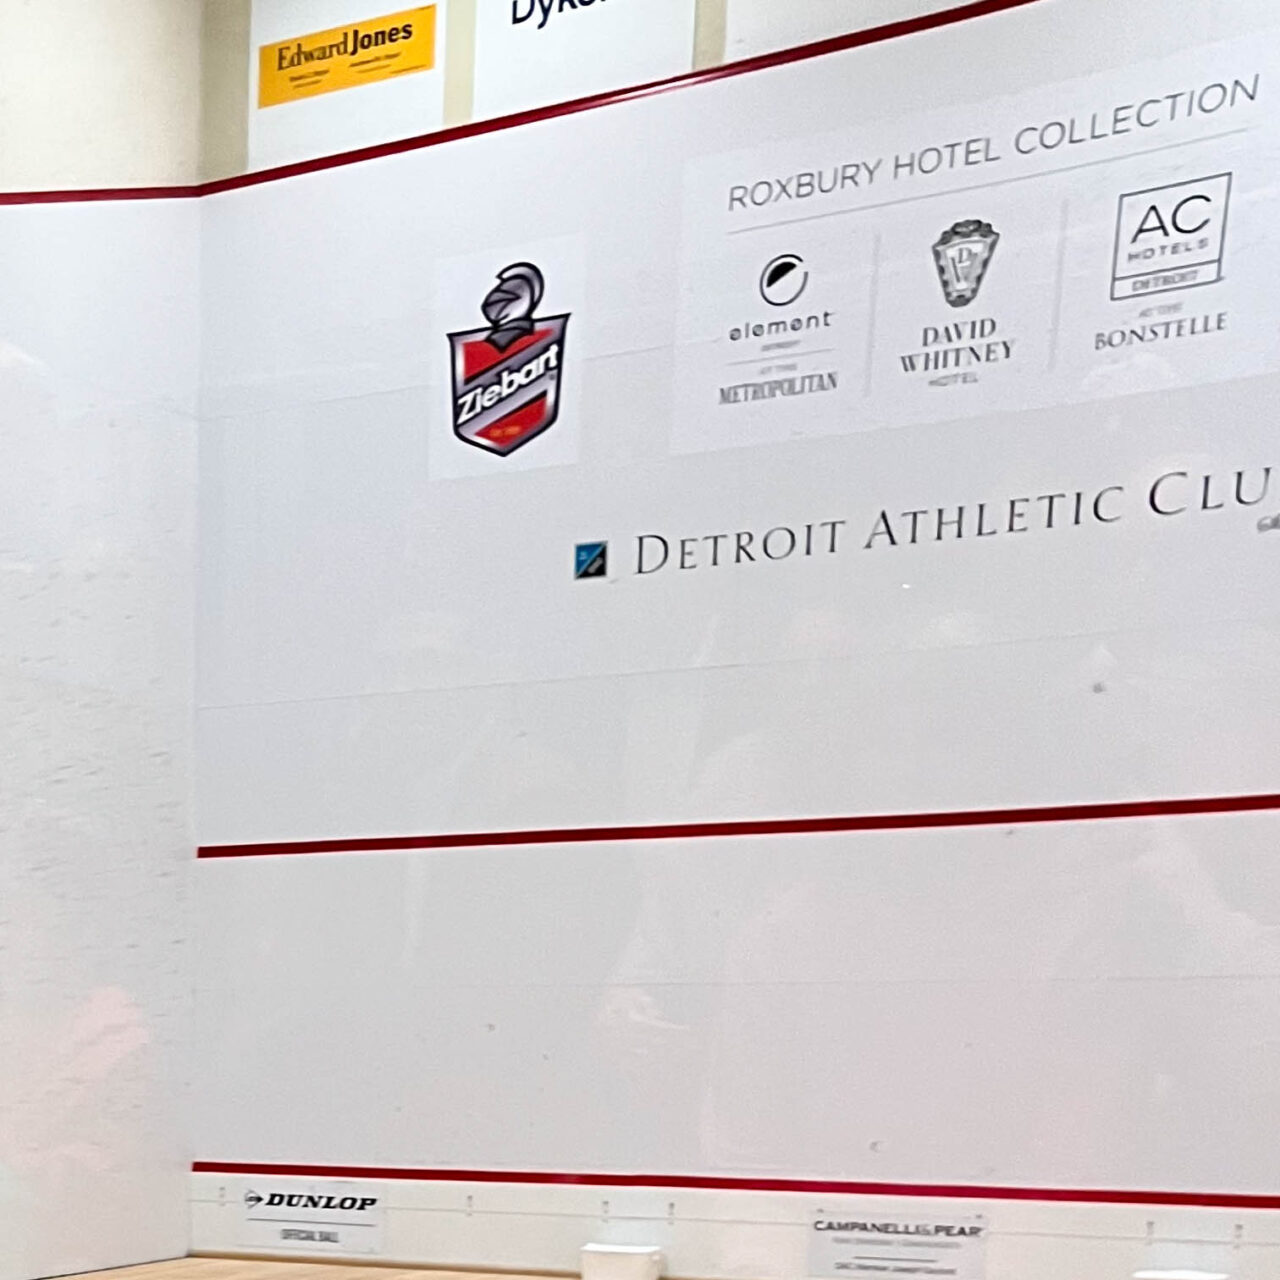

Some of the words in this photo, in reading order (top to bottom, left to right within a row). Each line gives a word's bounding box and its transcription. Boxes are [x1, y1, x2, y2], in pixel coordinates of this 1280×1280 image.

[728, 158, 883, 212] ROXBURY
[893, 137, 1001, 179] HOTEL
[1014, 73, 1260, 154] COLLECTION
[1130, 194, 1212, 244] AC
[922, 317, 997, 347] DAVID
[1094, 311, 1227, 351] BONSTELLE
[900, 338, 1016, 373] WHITNEY
[457, 343, 559, 424] Ziebart
[634, 520, 847, 575] DETROIT
[863, 485, 1125, 549] ATHLETIC
[1149, 466, 1272, 516] CLU
[265, 1193, 377, 1211] DUNLOP
